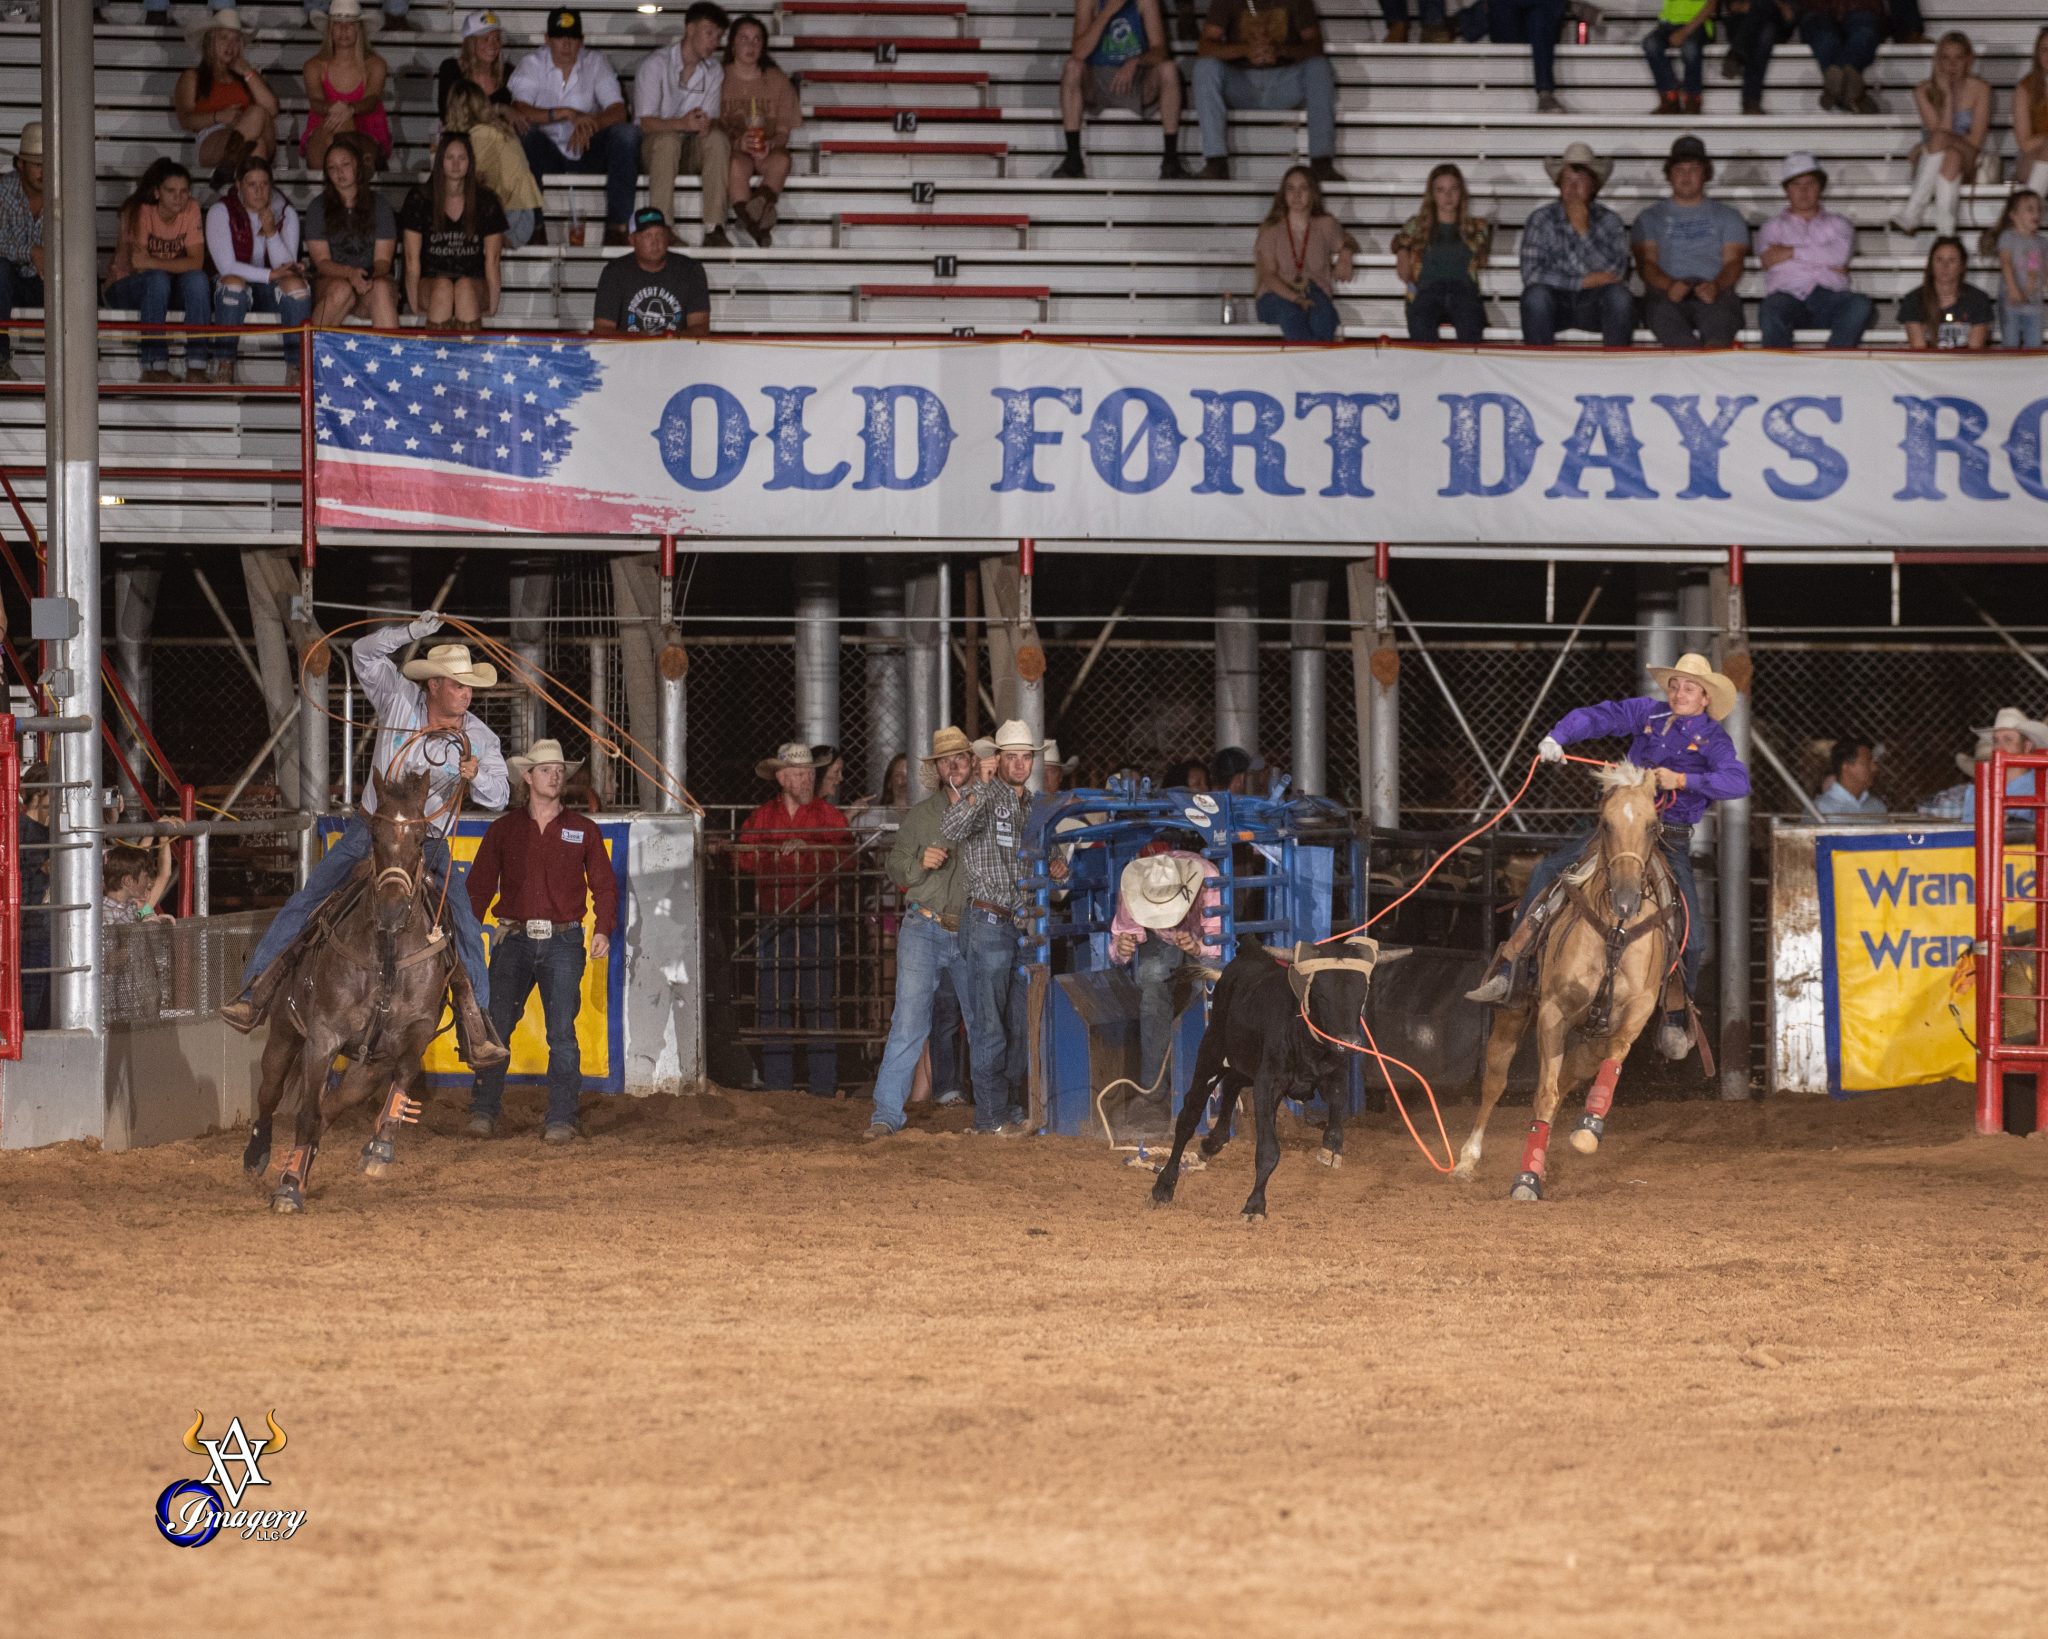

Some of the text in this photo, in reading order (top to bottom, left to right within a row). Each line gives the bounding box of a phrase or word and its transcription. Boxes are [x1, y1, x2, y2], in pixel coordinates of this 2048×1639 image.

[878, 43, 896, 62] 14
[896, 112, 916, 131] 13
[915, 183, 934, 202] 12
[937, 257, 955, 276] 11
[651, 383, 958, 492] OLD
[1437, 392, 1850, 501] DAYS
[1857, 863, 2037, 909] Wranle
